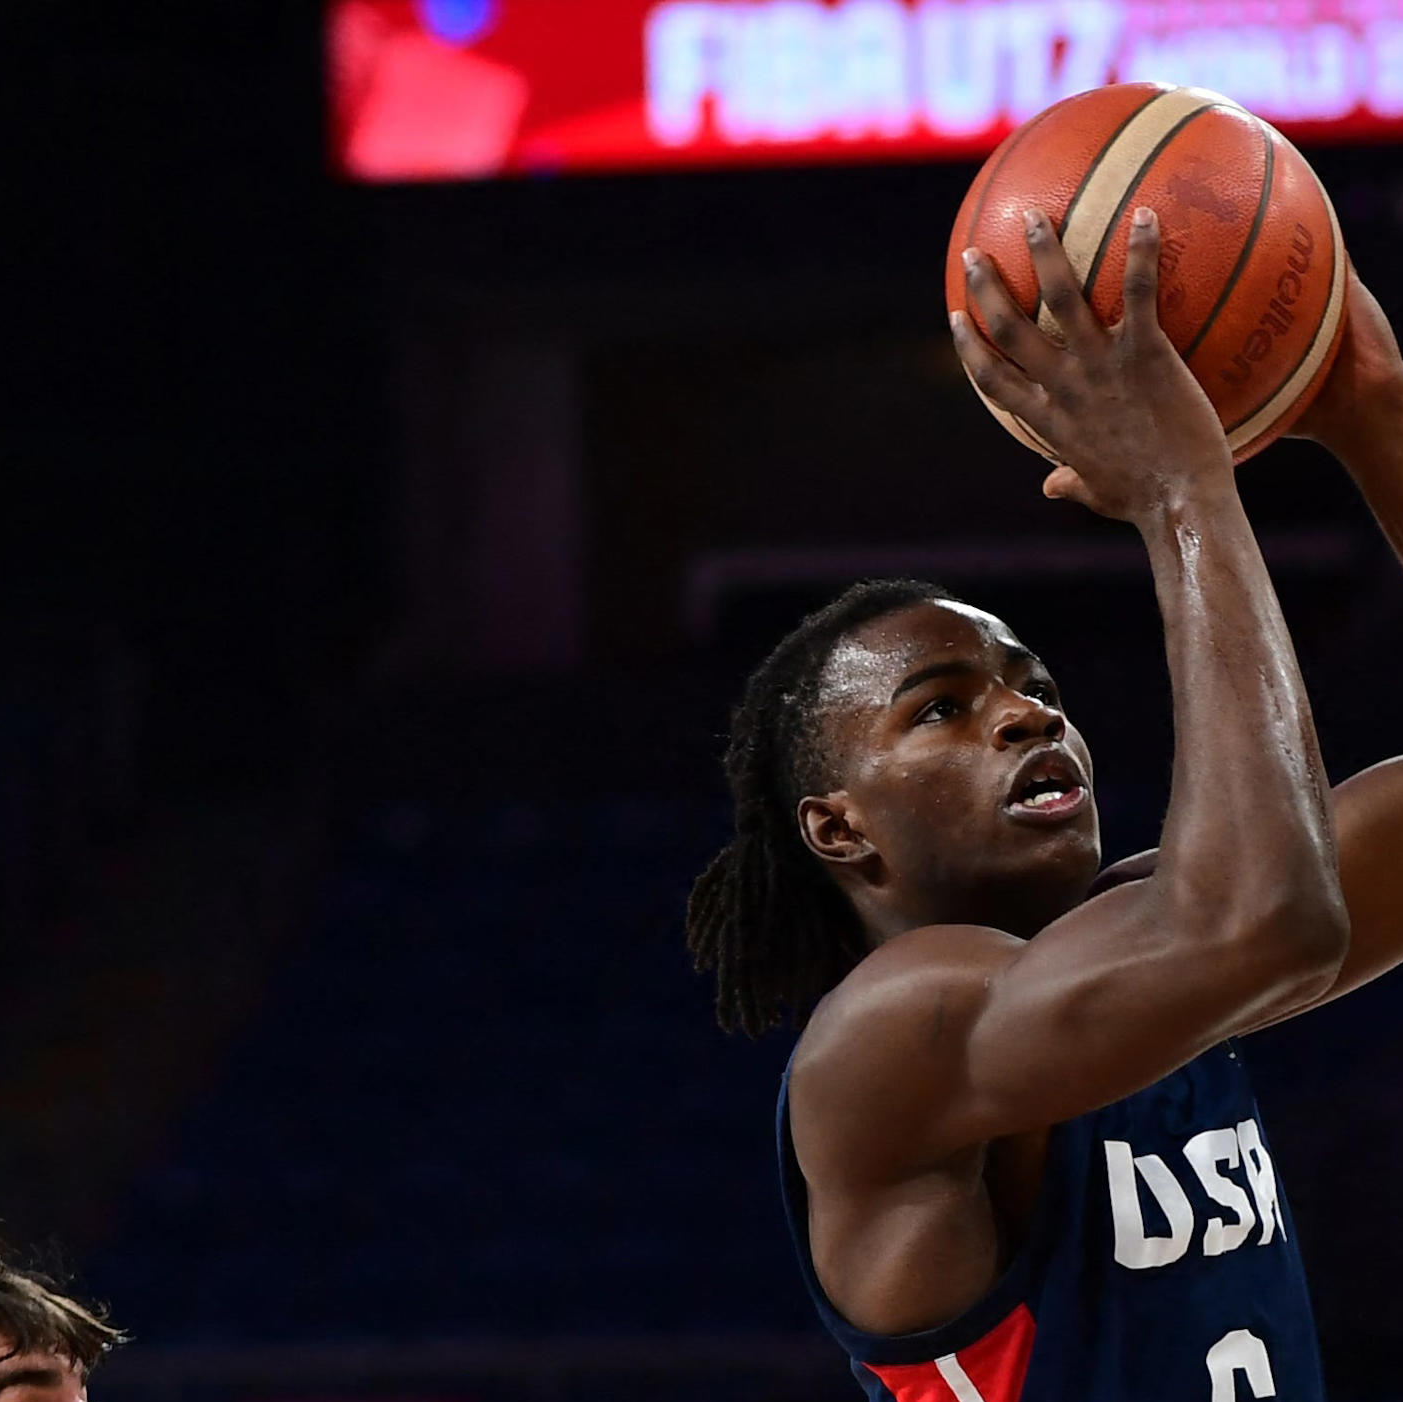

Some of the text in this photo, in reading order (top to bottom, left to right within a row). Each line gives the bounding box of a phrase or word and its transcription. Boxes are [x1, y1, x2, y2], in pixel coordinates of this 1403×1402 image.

[645, 0, 905, 144] FIBA
[1222, 223, 1316, 387] molten
[1103, 1118, 1288, 1270] USA
